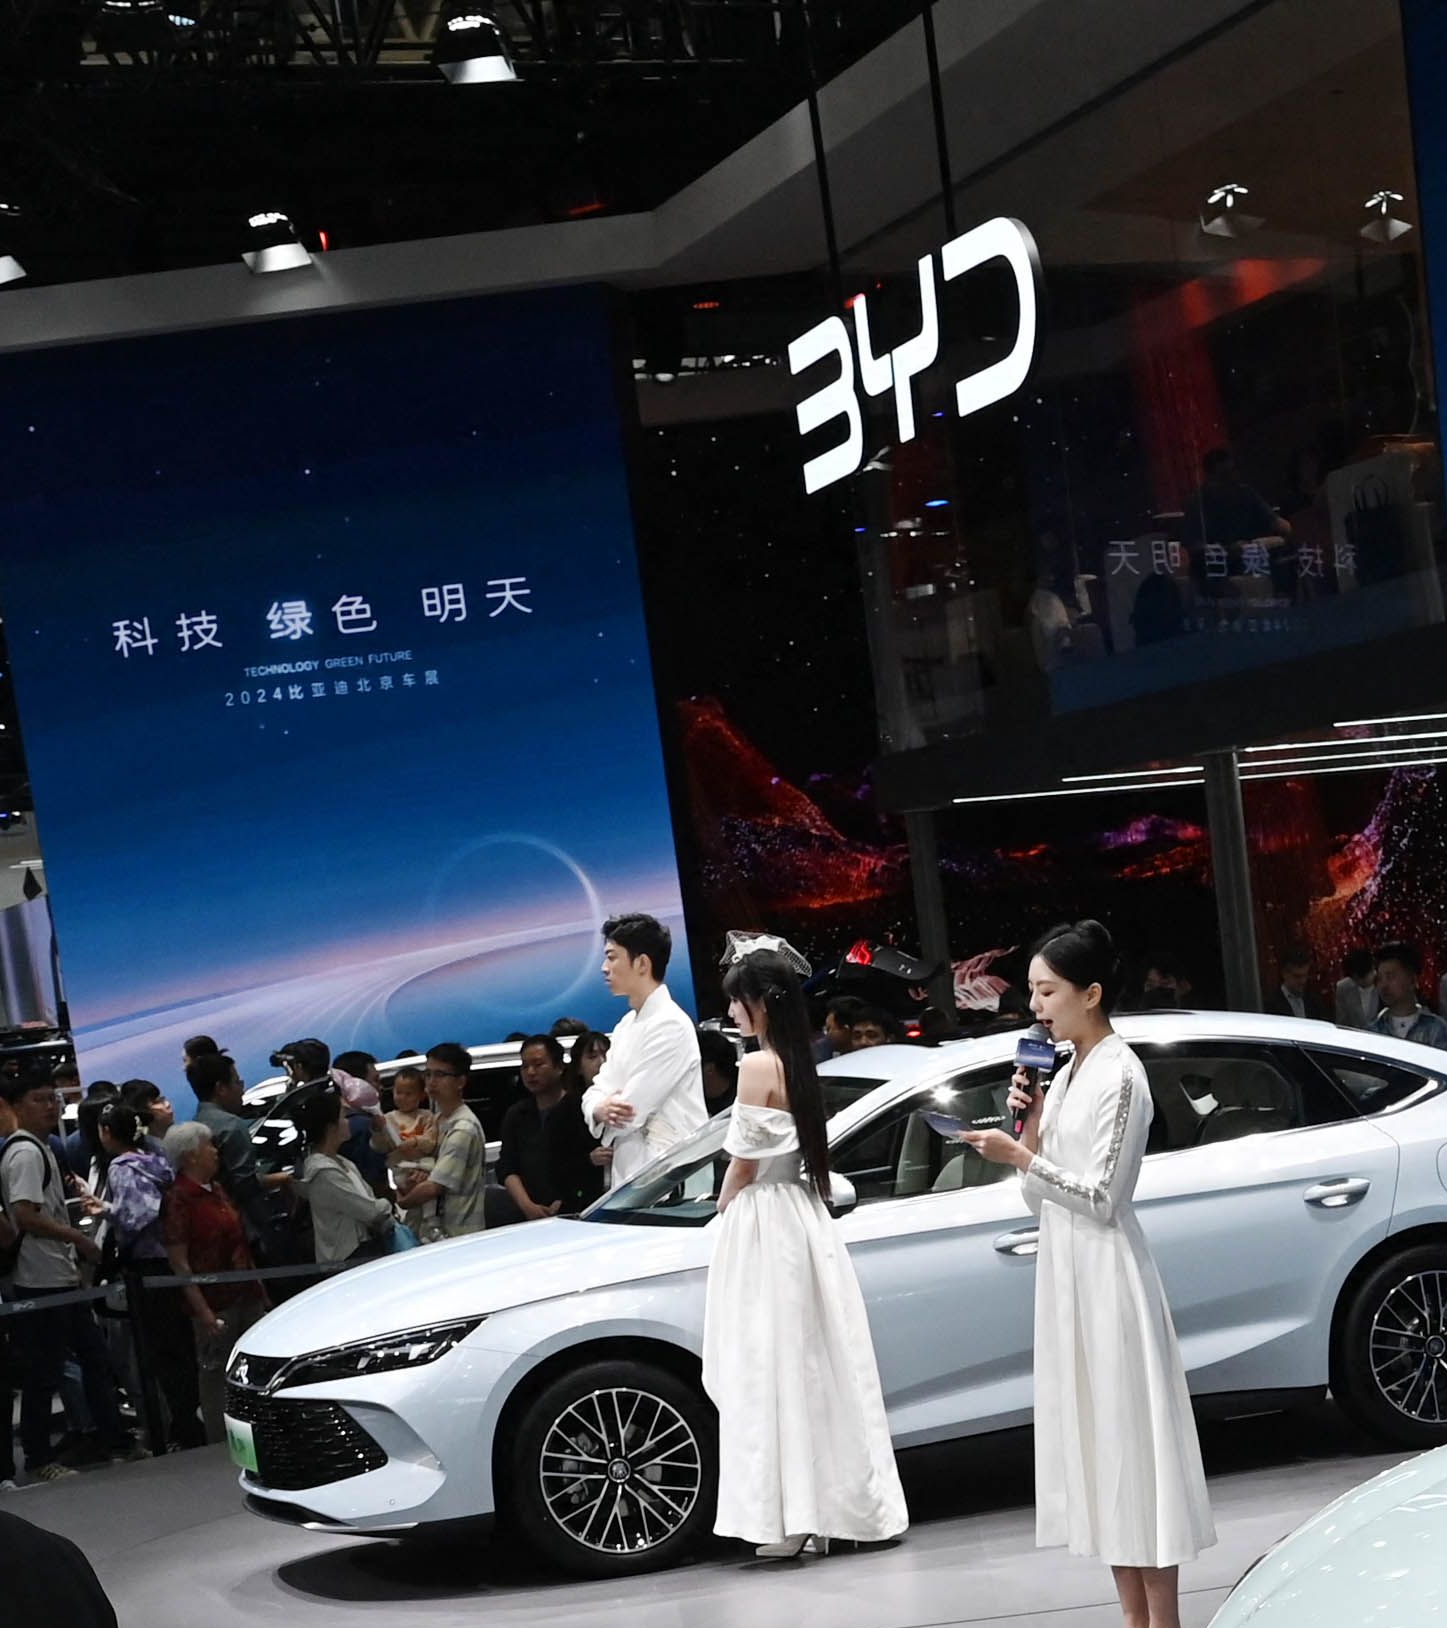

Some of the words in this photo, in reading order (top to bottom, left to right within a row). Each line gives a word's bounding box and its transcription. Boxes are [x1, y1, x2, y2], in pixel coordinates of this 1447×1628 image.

[787, 217, 1039, 495] BYD
[112, 610, 223, 658] 科技
[266, 594, 377, 640] 绿色
[420, 576, 533, 623] 明天
[225, 669, 440, 707] 2024比亚迪北京车展
[243, 659, 319, 678] TECHNOLOGY
[325, 655, 363, 669] GREEN
[368, 649, 413, 664] FUTURE
